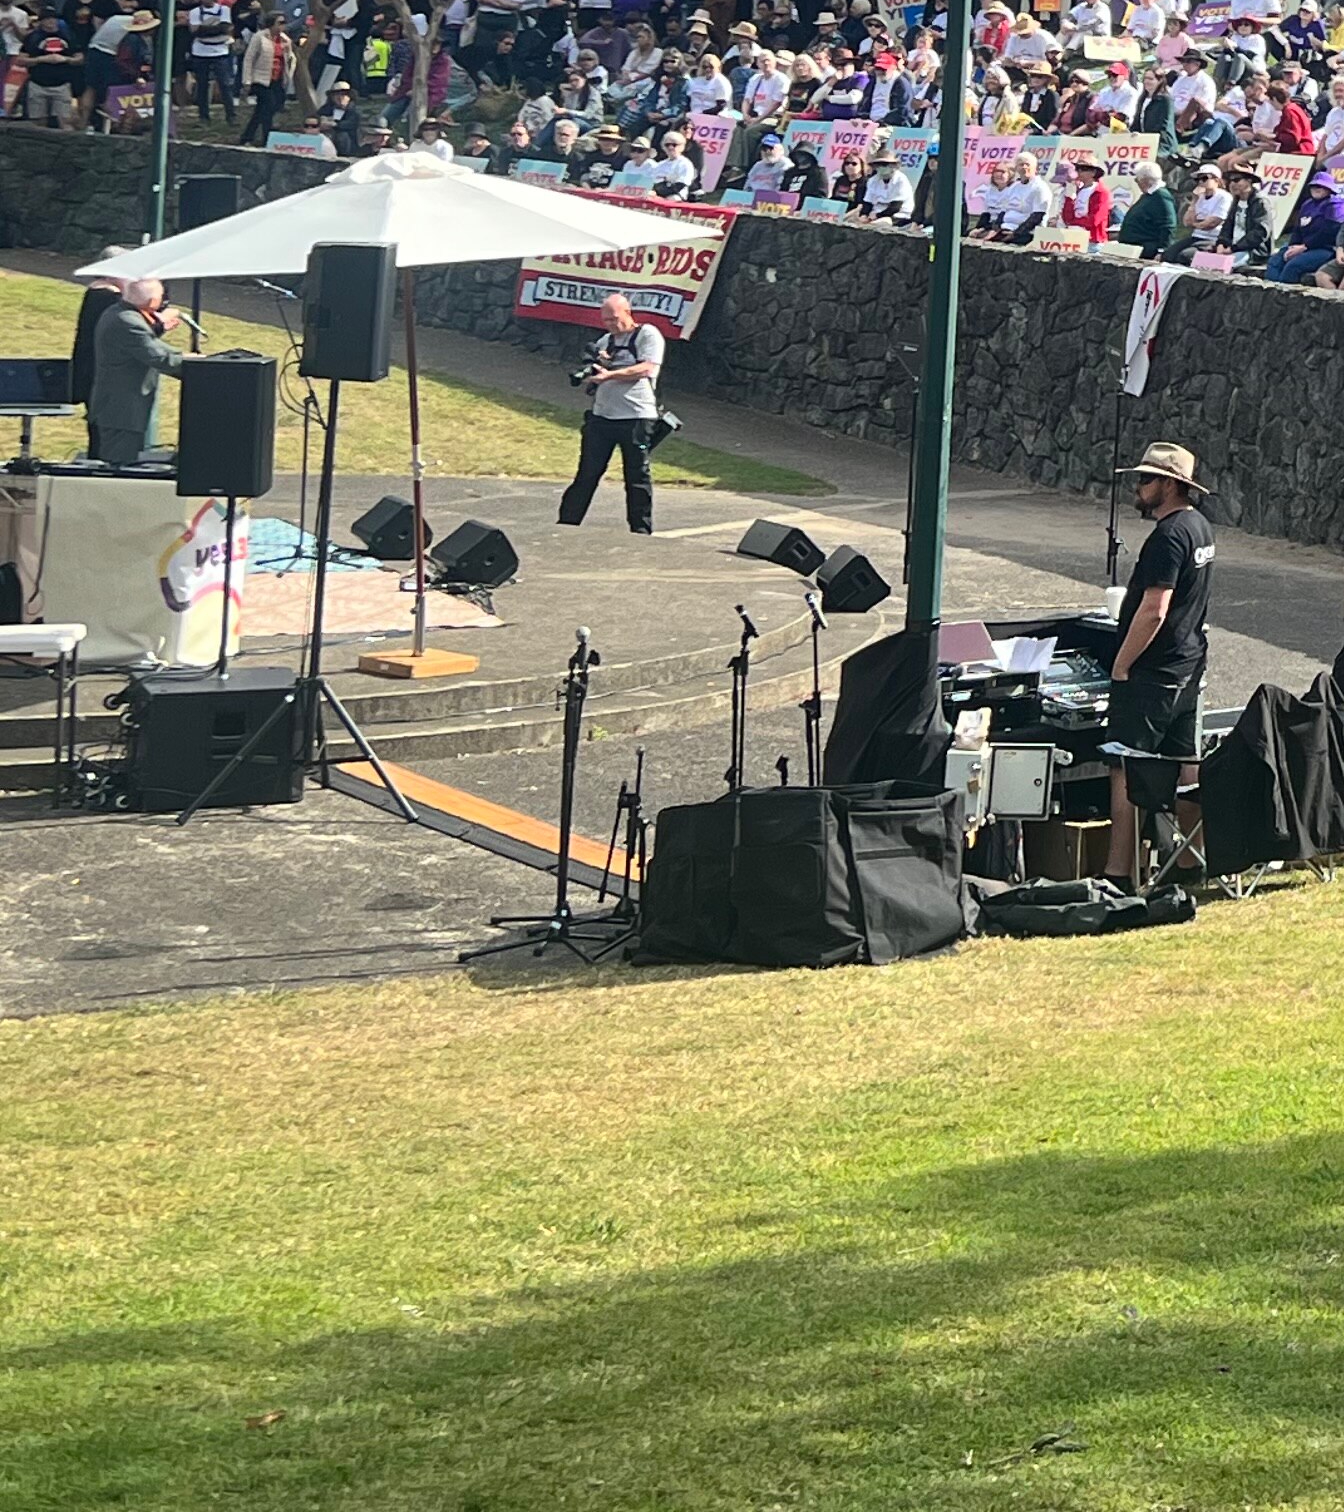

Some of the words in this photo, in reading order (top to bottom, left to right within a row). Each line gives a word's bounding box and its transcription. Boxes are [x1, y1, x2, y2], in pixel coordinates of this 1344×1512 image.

[117, 93, 153, 108] VOT
[791, 132, 826, 145] VOTE
[835, 131, 867, 146] VOTE
[701, 142, 724, 155] ES!
[893, 139, 927, 152] VOTE
[981, 147, 1016, 159] VOTE
[1107, 146, 1150, 159] VOTE
[899, 153, 921, 169] ES!
[1264, 165, 1303, 179] VOTE
